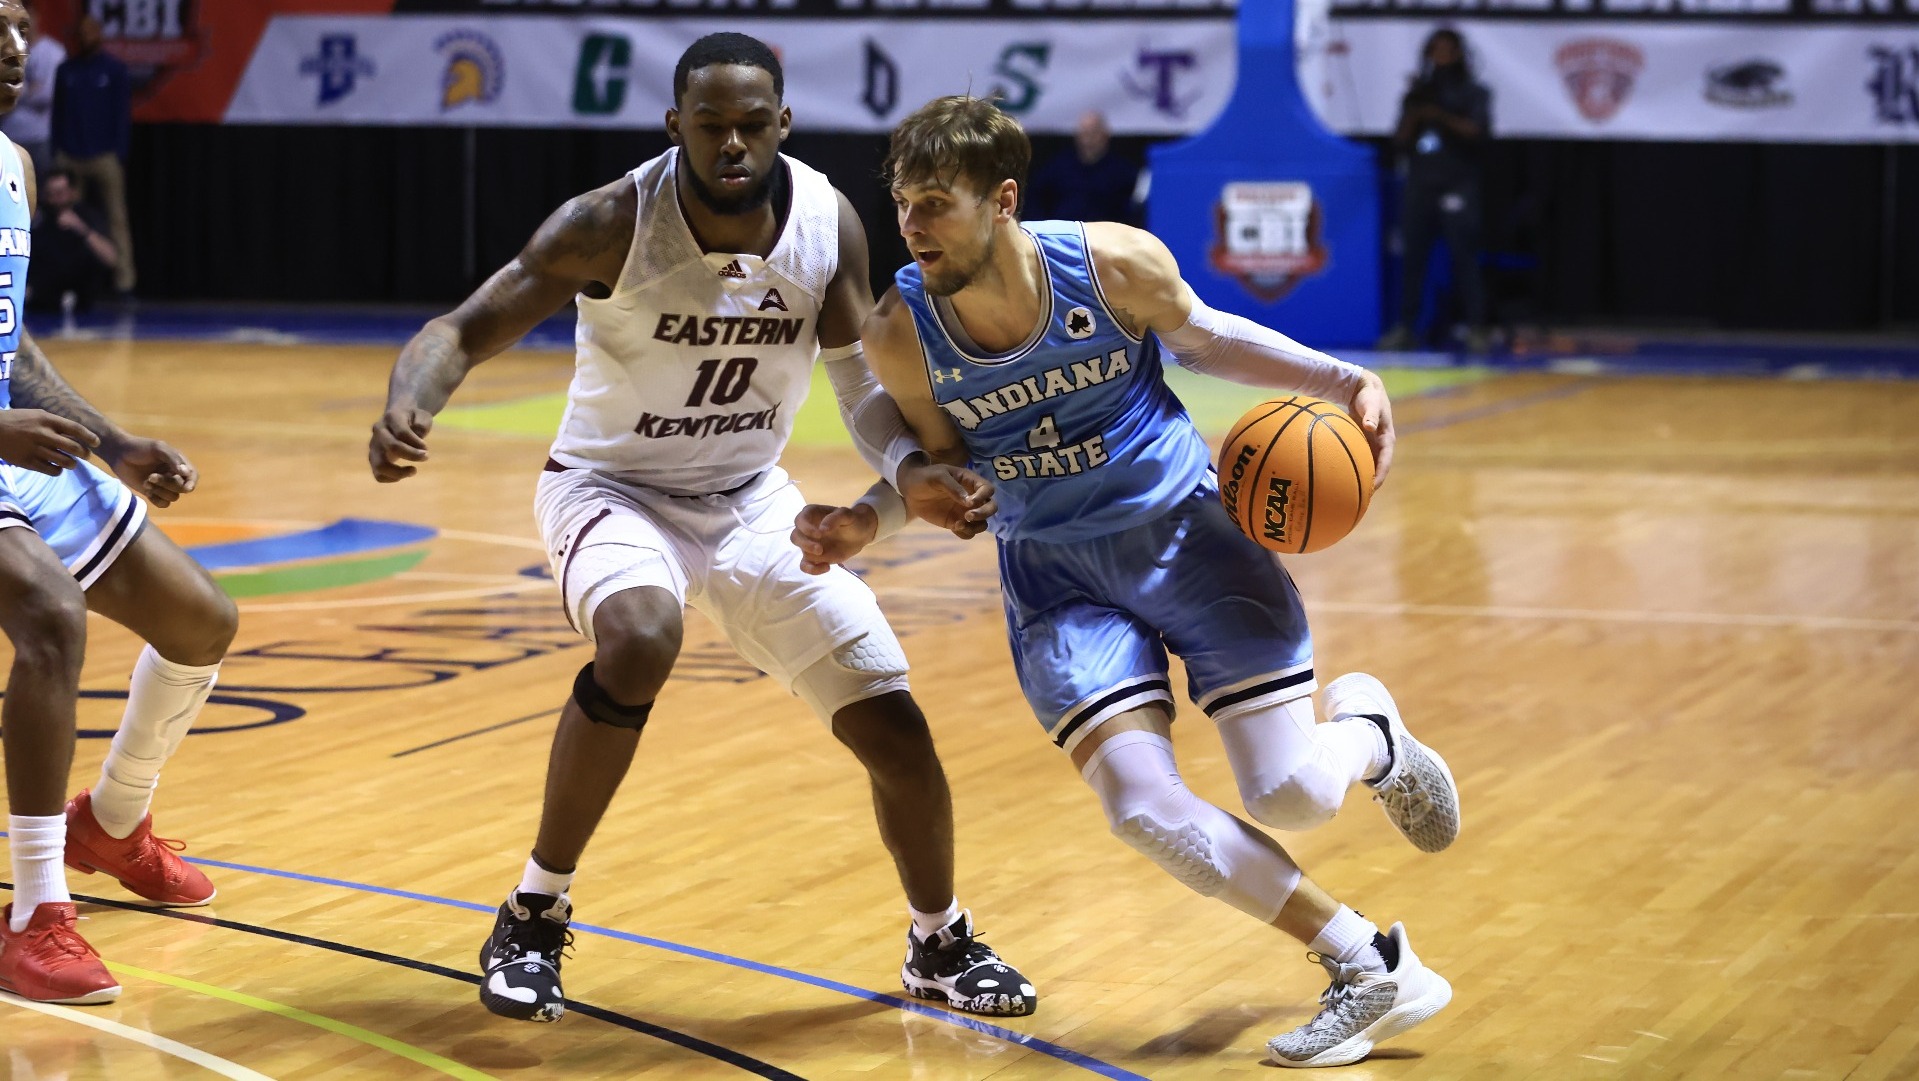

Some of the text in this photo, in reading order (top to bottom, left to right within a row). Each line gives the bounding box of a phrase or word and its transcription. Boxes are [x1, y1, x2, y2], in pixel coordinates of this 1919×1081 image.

[718, 270, 747, 279] adidas
[652, 313, 805, 346] EASTERN
[684, 357, 758, 408] 10
[634, 400, 782, 440] KENTUCKY
[1027, 413, 1064, 452] 4
[992, 434, 1111, 481] STATE
[1264, 477, 1292, 543] NCAA
